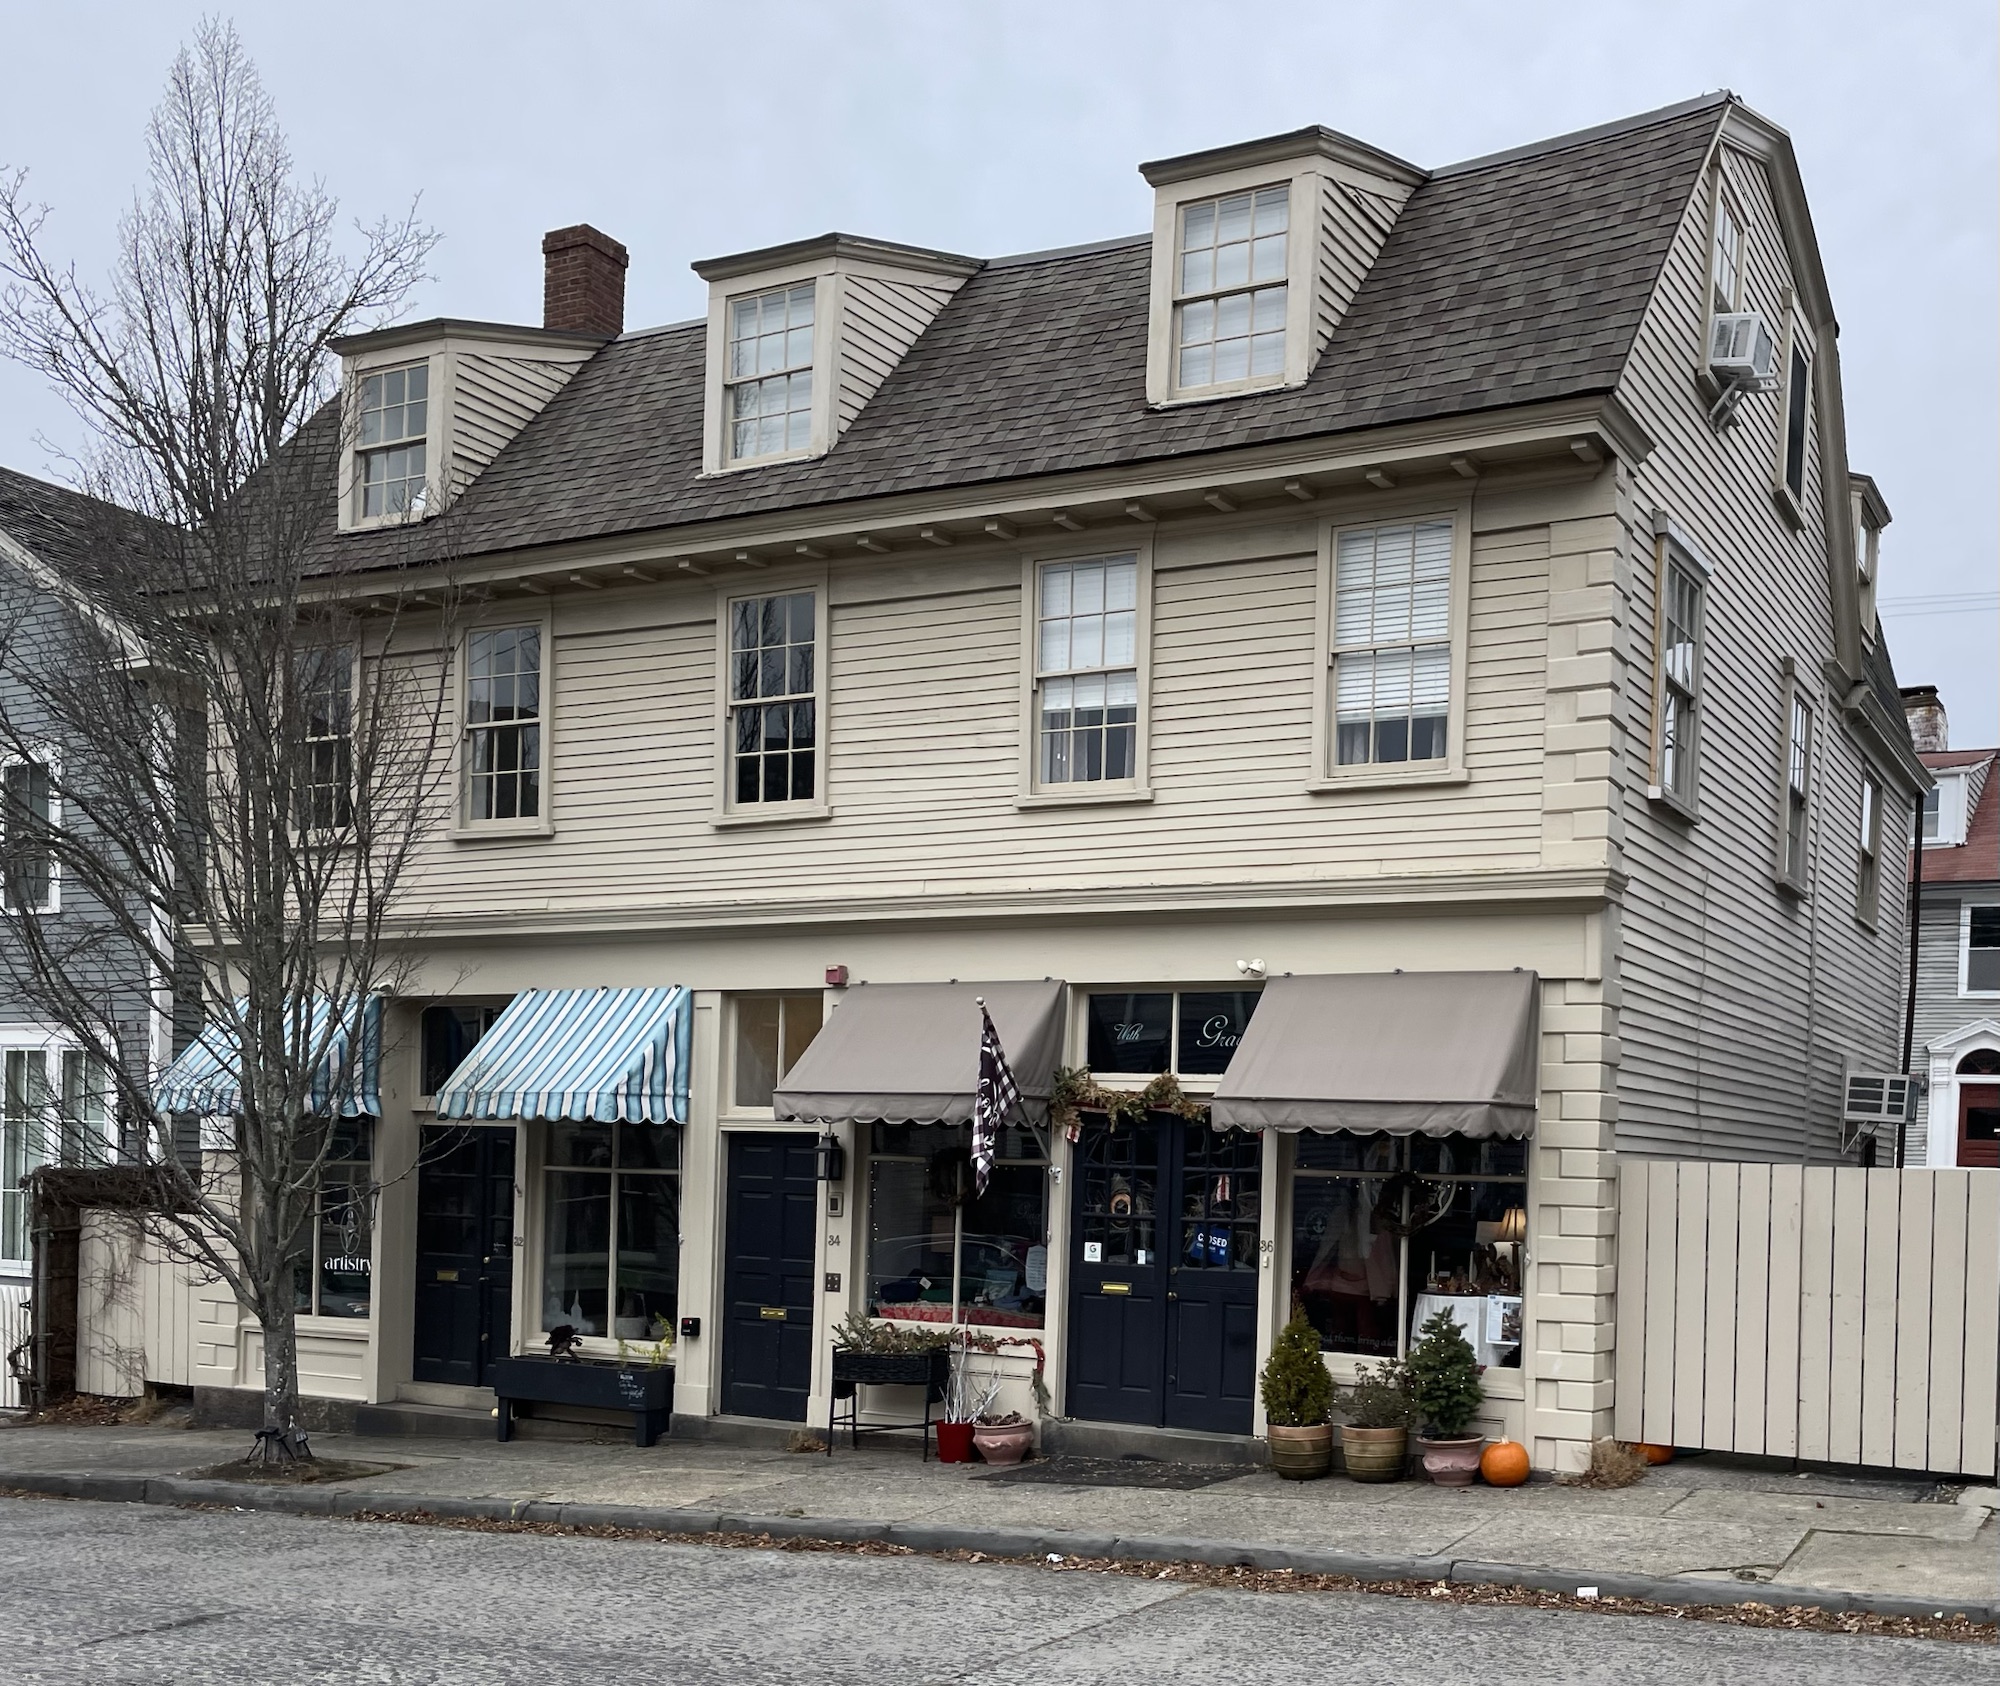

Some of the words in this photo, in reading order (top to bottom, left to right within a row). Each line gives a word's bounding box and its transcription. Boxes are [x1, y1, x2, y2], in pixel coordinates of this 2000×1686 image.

[1113, 1022, 1145, 1042] With
[827, 1235, 841, 1247] 34
[1197, 1232, 1228, 1248] CSED
[1259, 1239, 1274, 1253] 36
[324, 1254, 371, 1276] artistry
